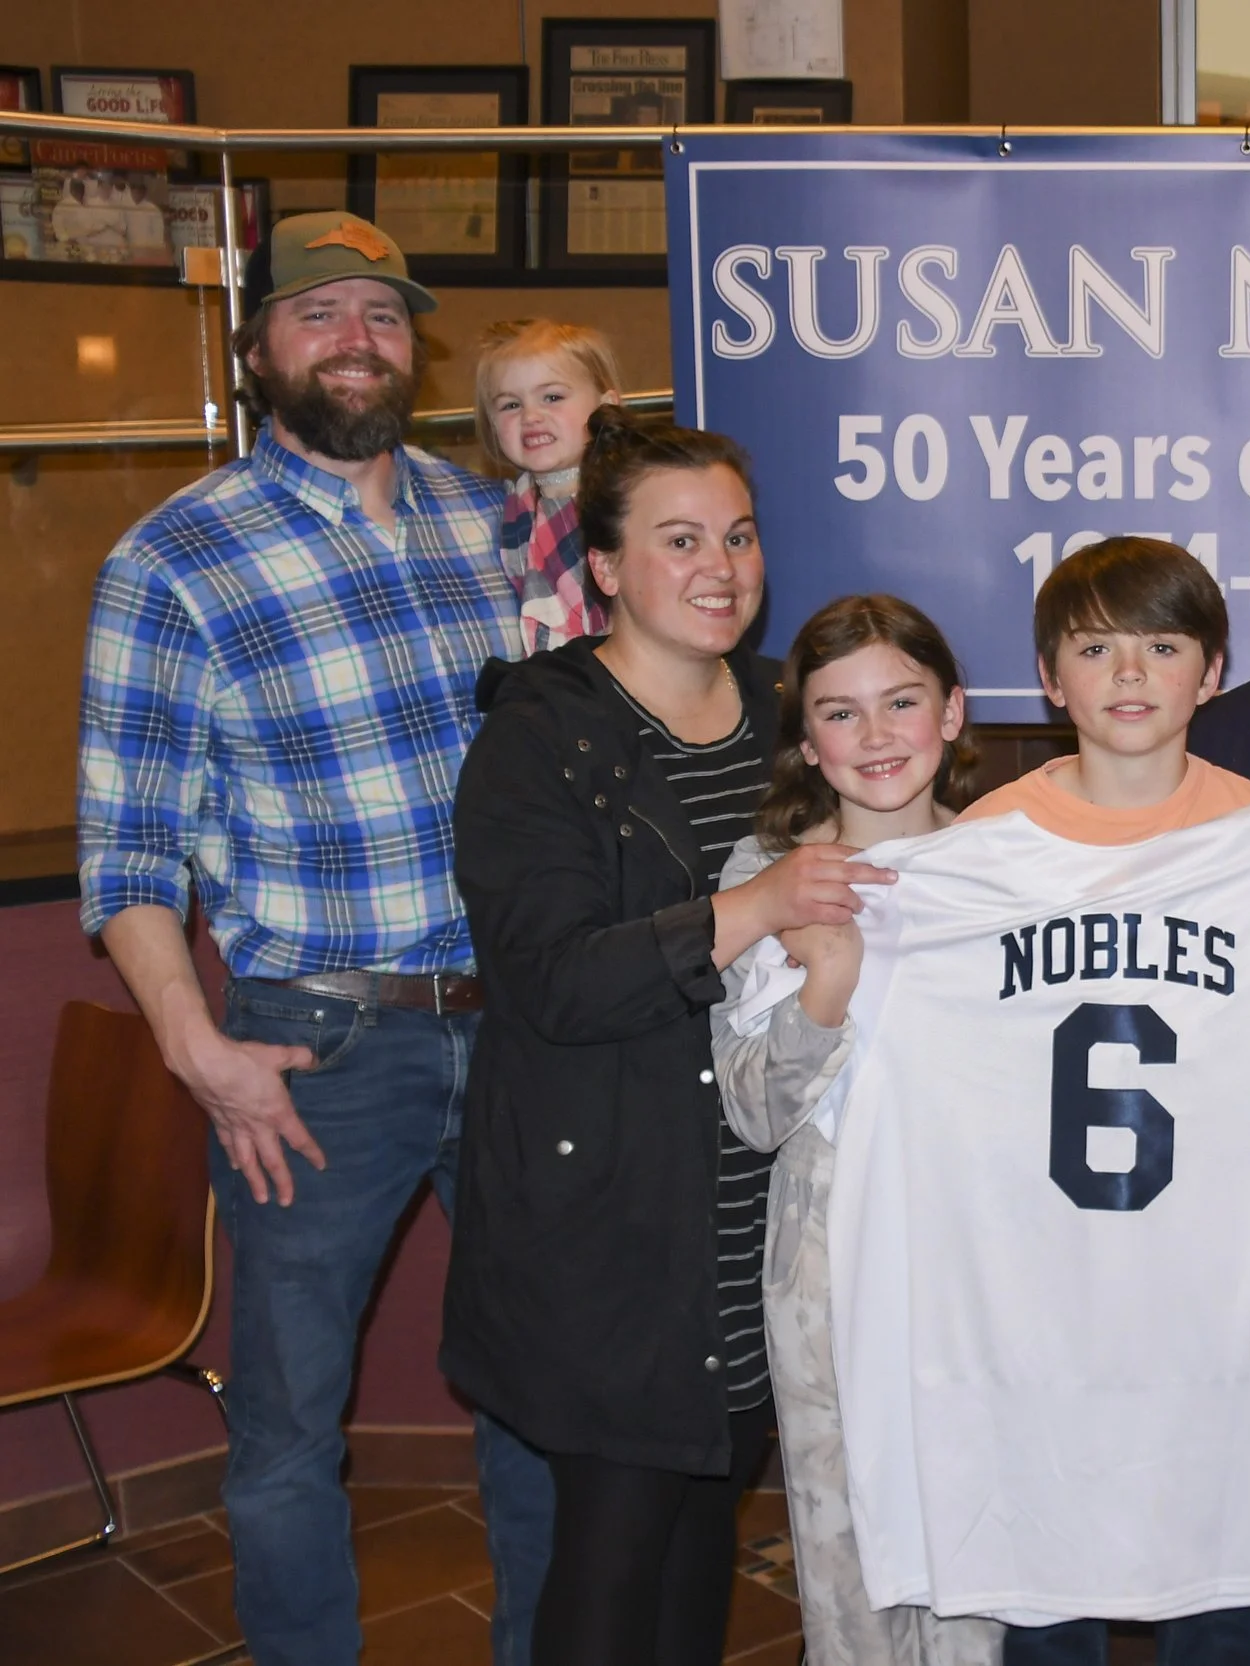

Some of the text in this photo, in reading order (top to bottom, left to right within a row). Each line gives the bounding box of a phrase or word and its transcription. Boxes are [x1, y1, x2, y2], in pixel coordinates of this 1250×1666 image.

[86, 97, 131, 113] GOOD
[712, 243, 1177, 360] SUSAN
[833, 413, 948, 501] 50
[969, 414, 1211, 501] Years
[999, 913, 1235, 1001] NOBLES
[1048, 1002, 1178, 1212] 6
